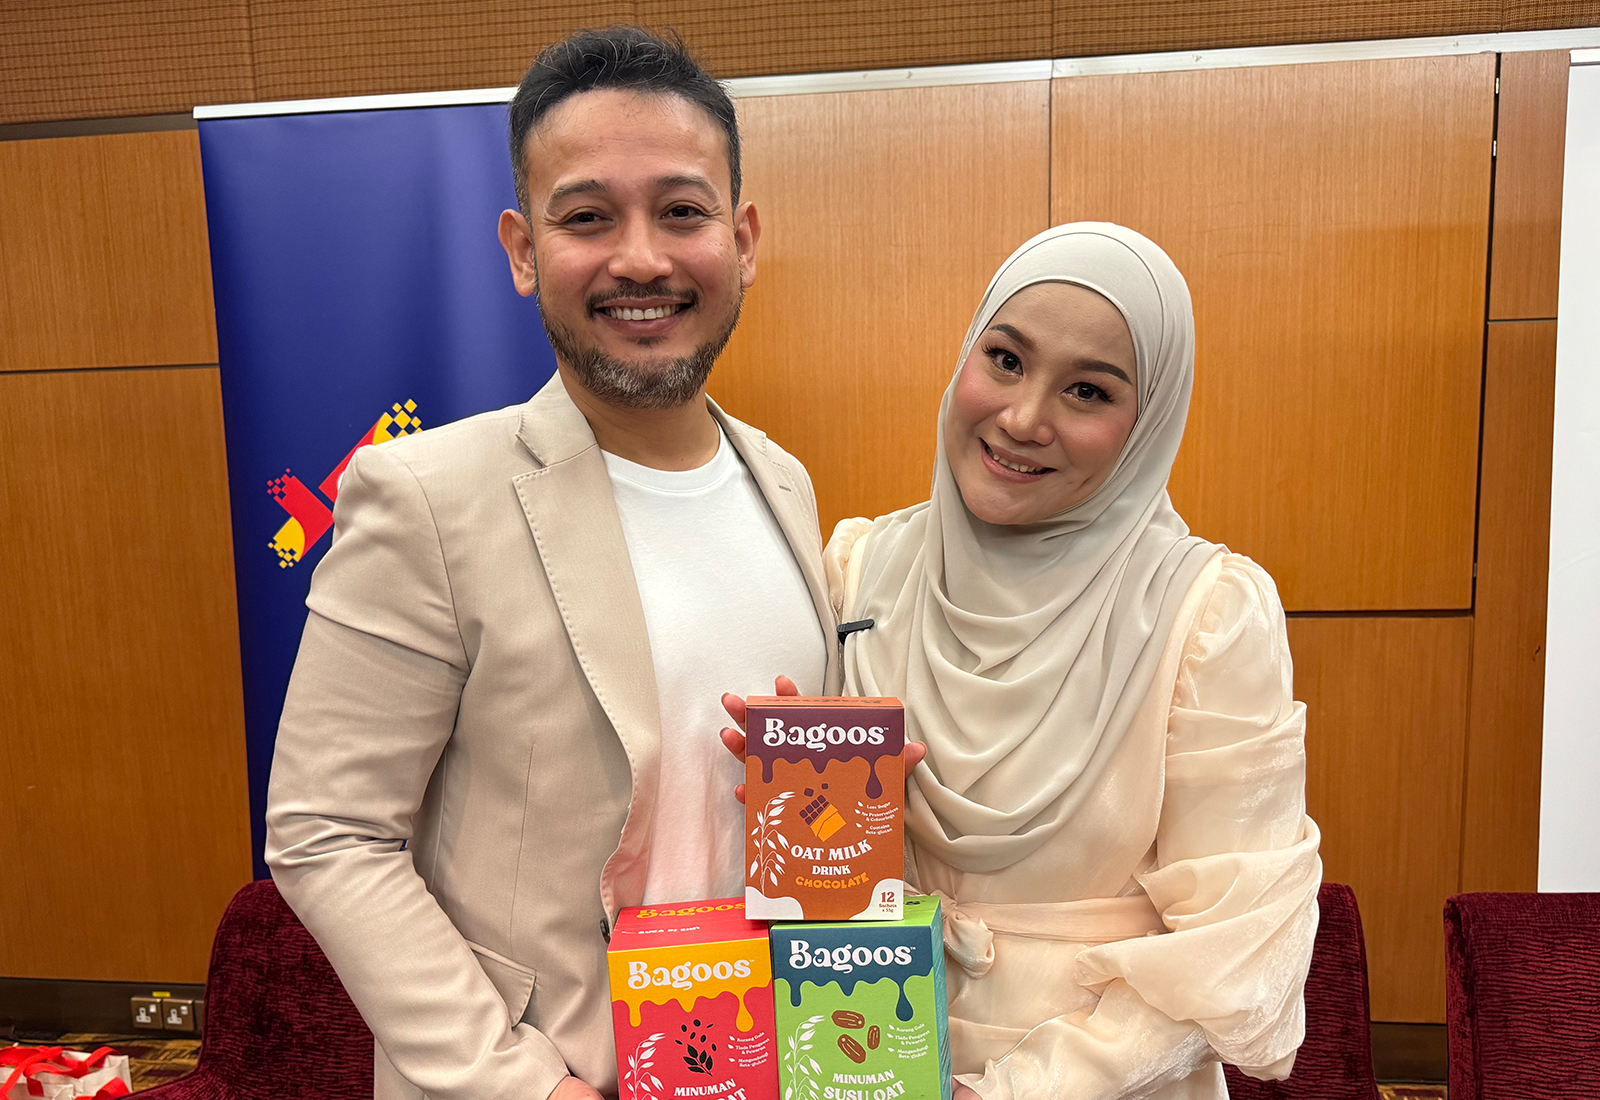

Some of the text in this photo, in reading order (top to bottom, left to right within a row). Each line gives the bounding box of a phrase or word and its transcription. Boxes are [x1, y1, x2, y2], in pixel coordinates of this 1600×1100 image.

[762, 717, 885, 752] Bagoos
[877, 801, 891, 809] Sugar
[790, 839, 873, 861] OAT MILK
[812, 864, 851, 876] DRINK
[795, 871, 870, 890] CHOCOLATE
[881, 891, 895, 903] 12
[636, 902, 745, 919] Bagoos
[788, 939, 912, 974] Bagoos
[627, 959, 751, 991] Bagoos
[832, 1069, 895, 1085] MINUMAN
[673, 1078, 737, 1097] MINUMAN
[823, 1080, 906, 1100] SUSU OAT
